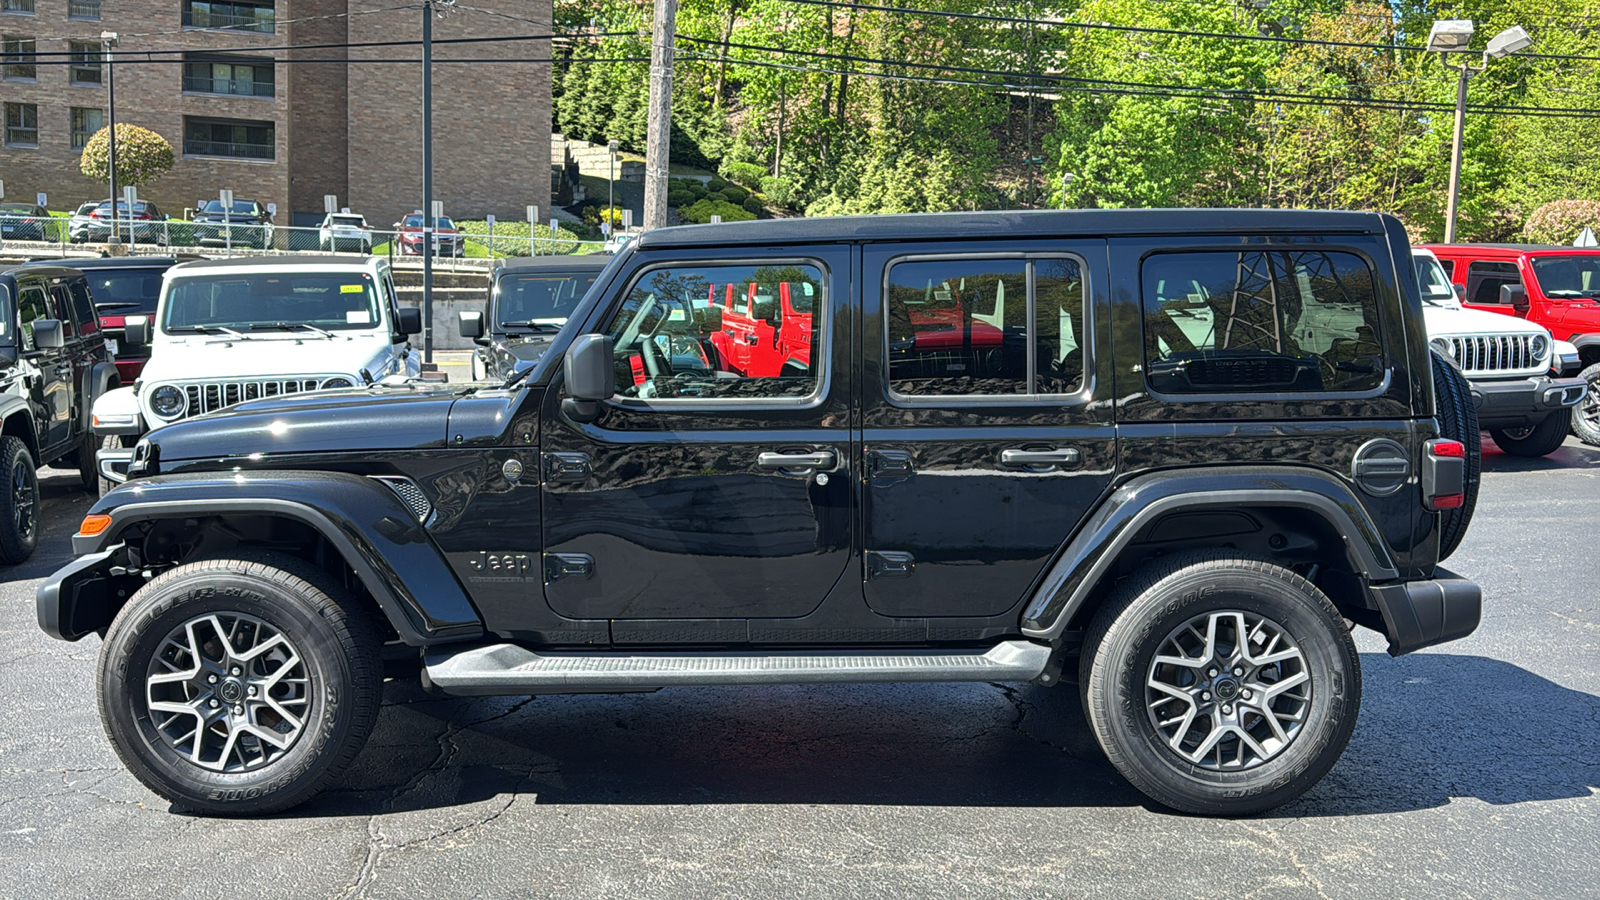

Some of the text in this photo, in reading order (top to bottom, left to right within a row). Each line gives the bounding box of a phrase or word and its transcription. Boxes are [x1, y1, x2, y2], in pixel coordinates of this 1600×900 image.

[470, 551, 531, 574] Jeep
[115, 587, 217, 682] DUELER
[1118, 585, 1216, 738] BRIDGESTONE
[207, 685, 339, 801] BRIDGESTONE
[1271, 670, 1344, 790] DUELER
